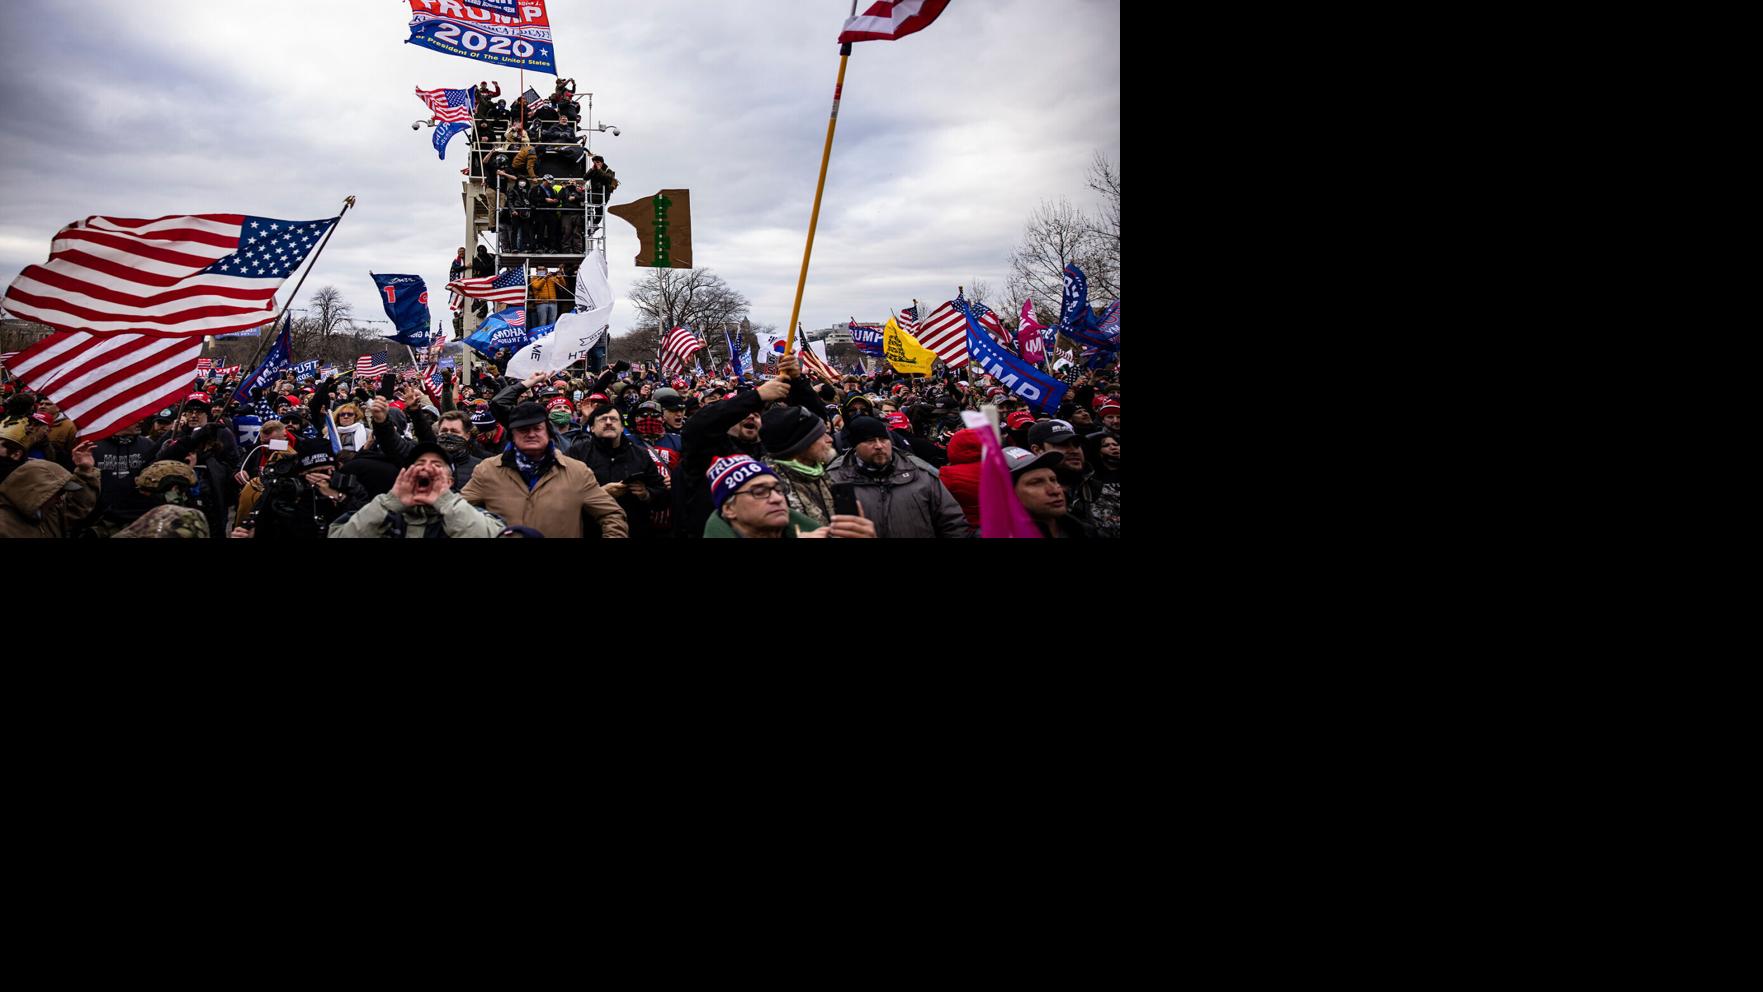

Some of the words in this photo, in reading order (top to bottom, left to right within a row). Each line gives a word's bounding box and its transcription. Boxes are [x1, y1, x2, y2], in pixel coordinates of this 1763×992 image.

[427, 37, 467, 55] President
[484, 53, 499, 61] The
[502, 56, 526, 64] United
[434, 23, 534, 58] 2020
[725, 463, 762, 489] 2016
